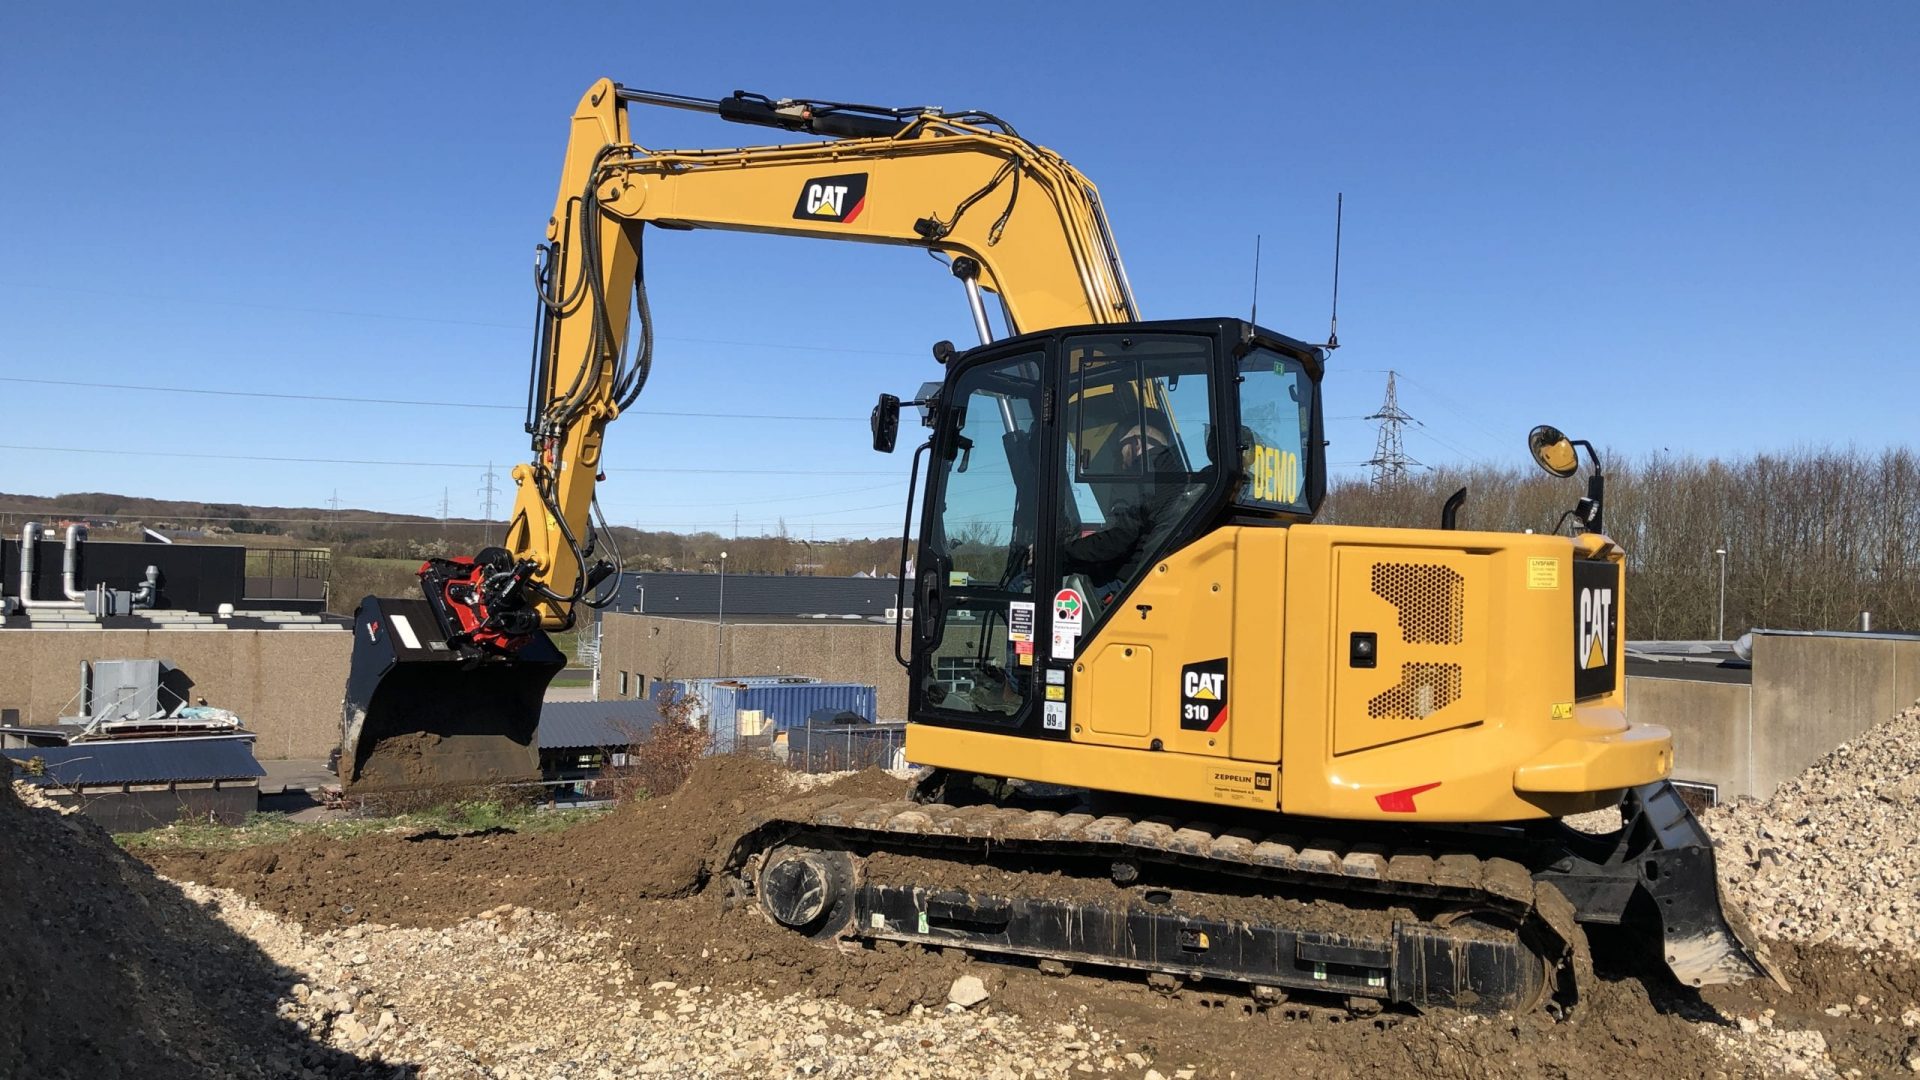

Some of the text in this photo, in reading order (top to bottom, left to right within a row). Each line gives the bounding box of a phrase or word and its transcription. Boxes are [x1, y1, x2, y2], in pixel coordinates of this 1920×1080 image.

[807, 184, 848, 216] CAT
[1254, 444, 1297, 504] DEMO
[1580, 587, 1611, 670] CAT
[1185, 671, 1224, 700] CAT
[1046, 713, 1057, 726] 99
[1184, 704, 1209, 721] 310
[1214, 773, 1252, 783] ZEPPELIN
[1256, 776, 1270, 787] CAT
